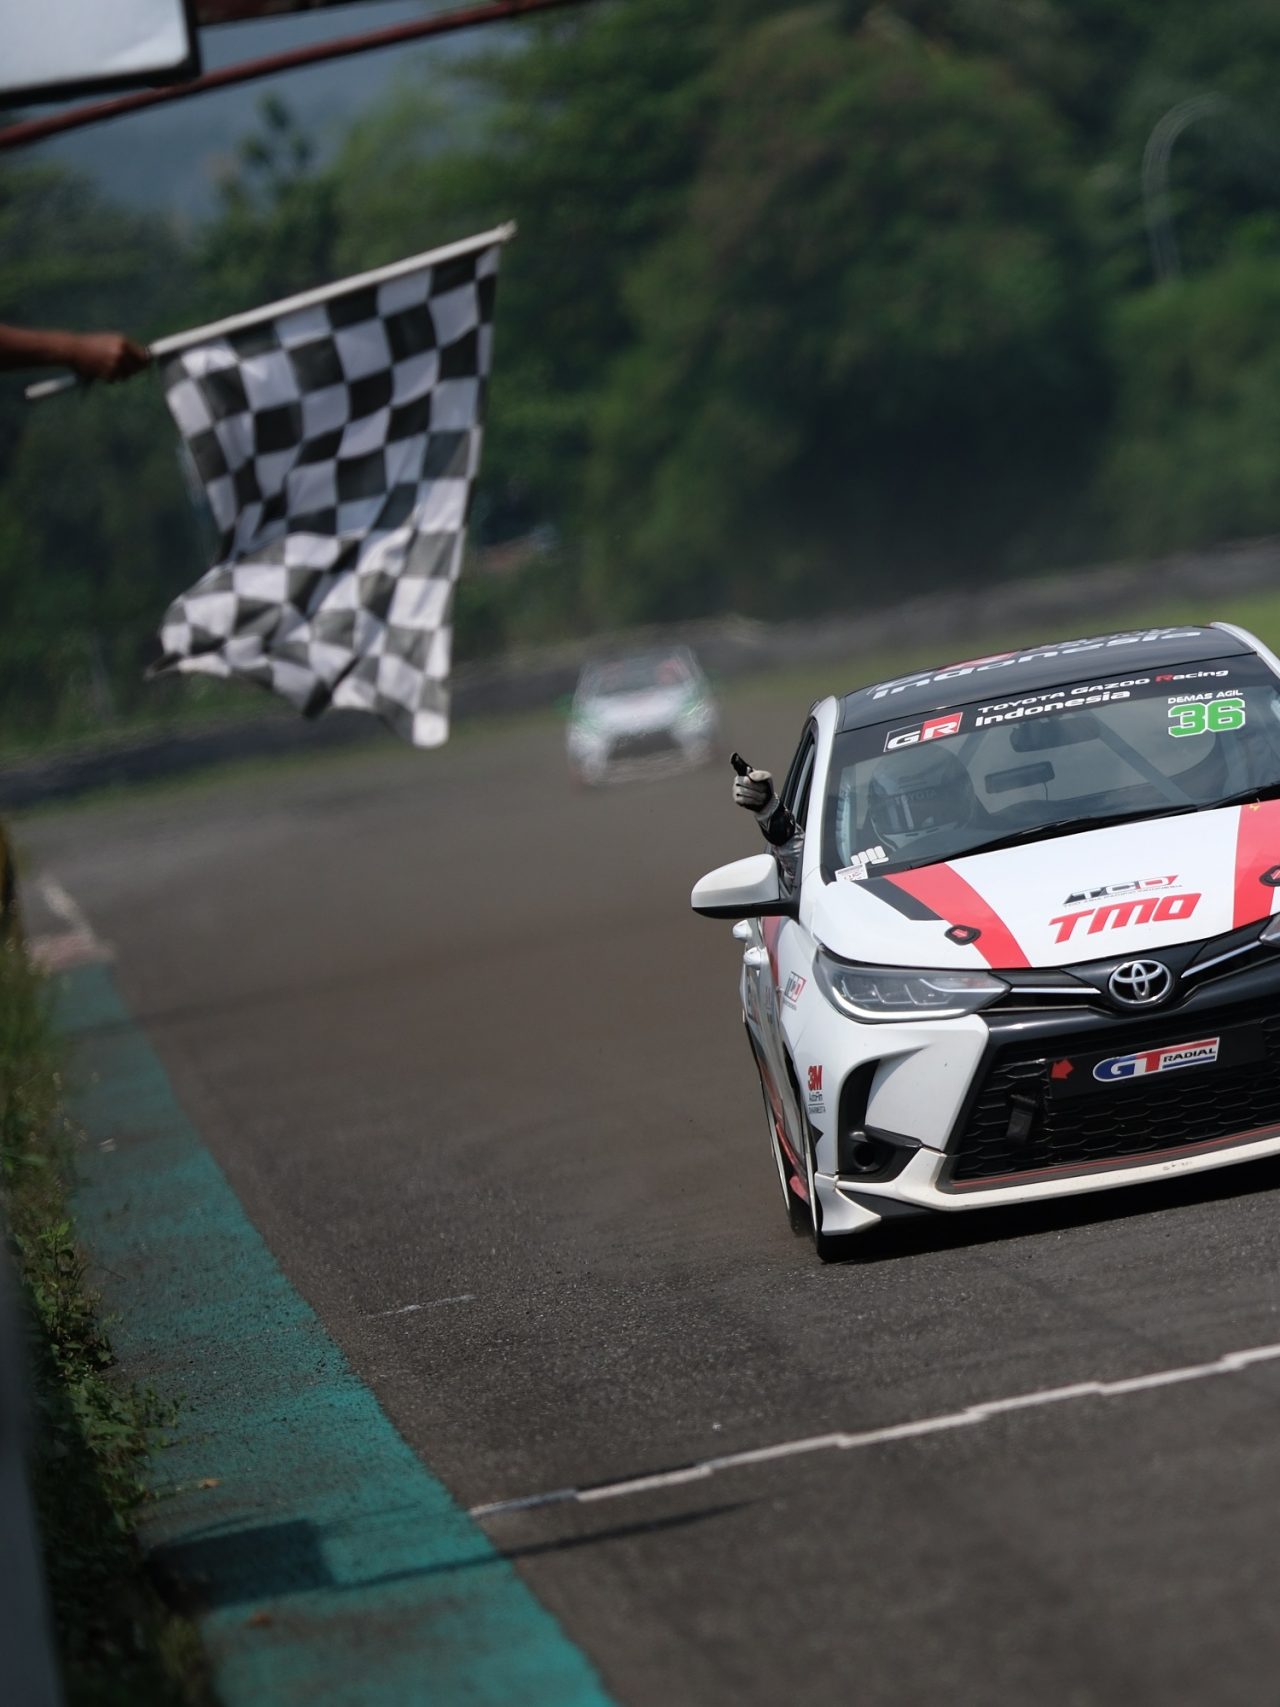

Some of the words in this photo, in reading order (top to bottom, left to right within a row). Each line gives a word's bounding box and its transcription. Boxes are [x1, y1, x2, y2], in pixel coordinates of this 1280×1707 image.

[978, 691, 1066, 714] TOYOTA
[1070, 677, 1151, 695] GAZOO
[1155, 669, 1229, 683] Racing
[1167, 692, 1214, 705] DEMAS
[1215, 689, 1244, 699] AGIL
[975, 690, 1131, 727] Indonesia
[1167, 697, 1246, 738] 36
[886, 720, 959, 750] GR
[1048, 892, 1202, 944] TMO
[1163, 1047, 1217, 1063] RADIAL
[807, 1064, 823, 1091] 3M
